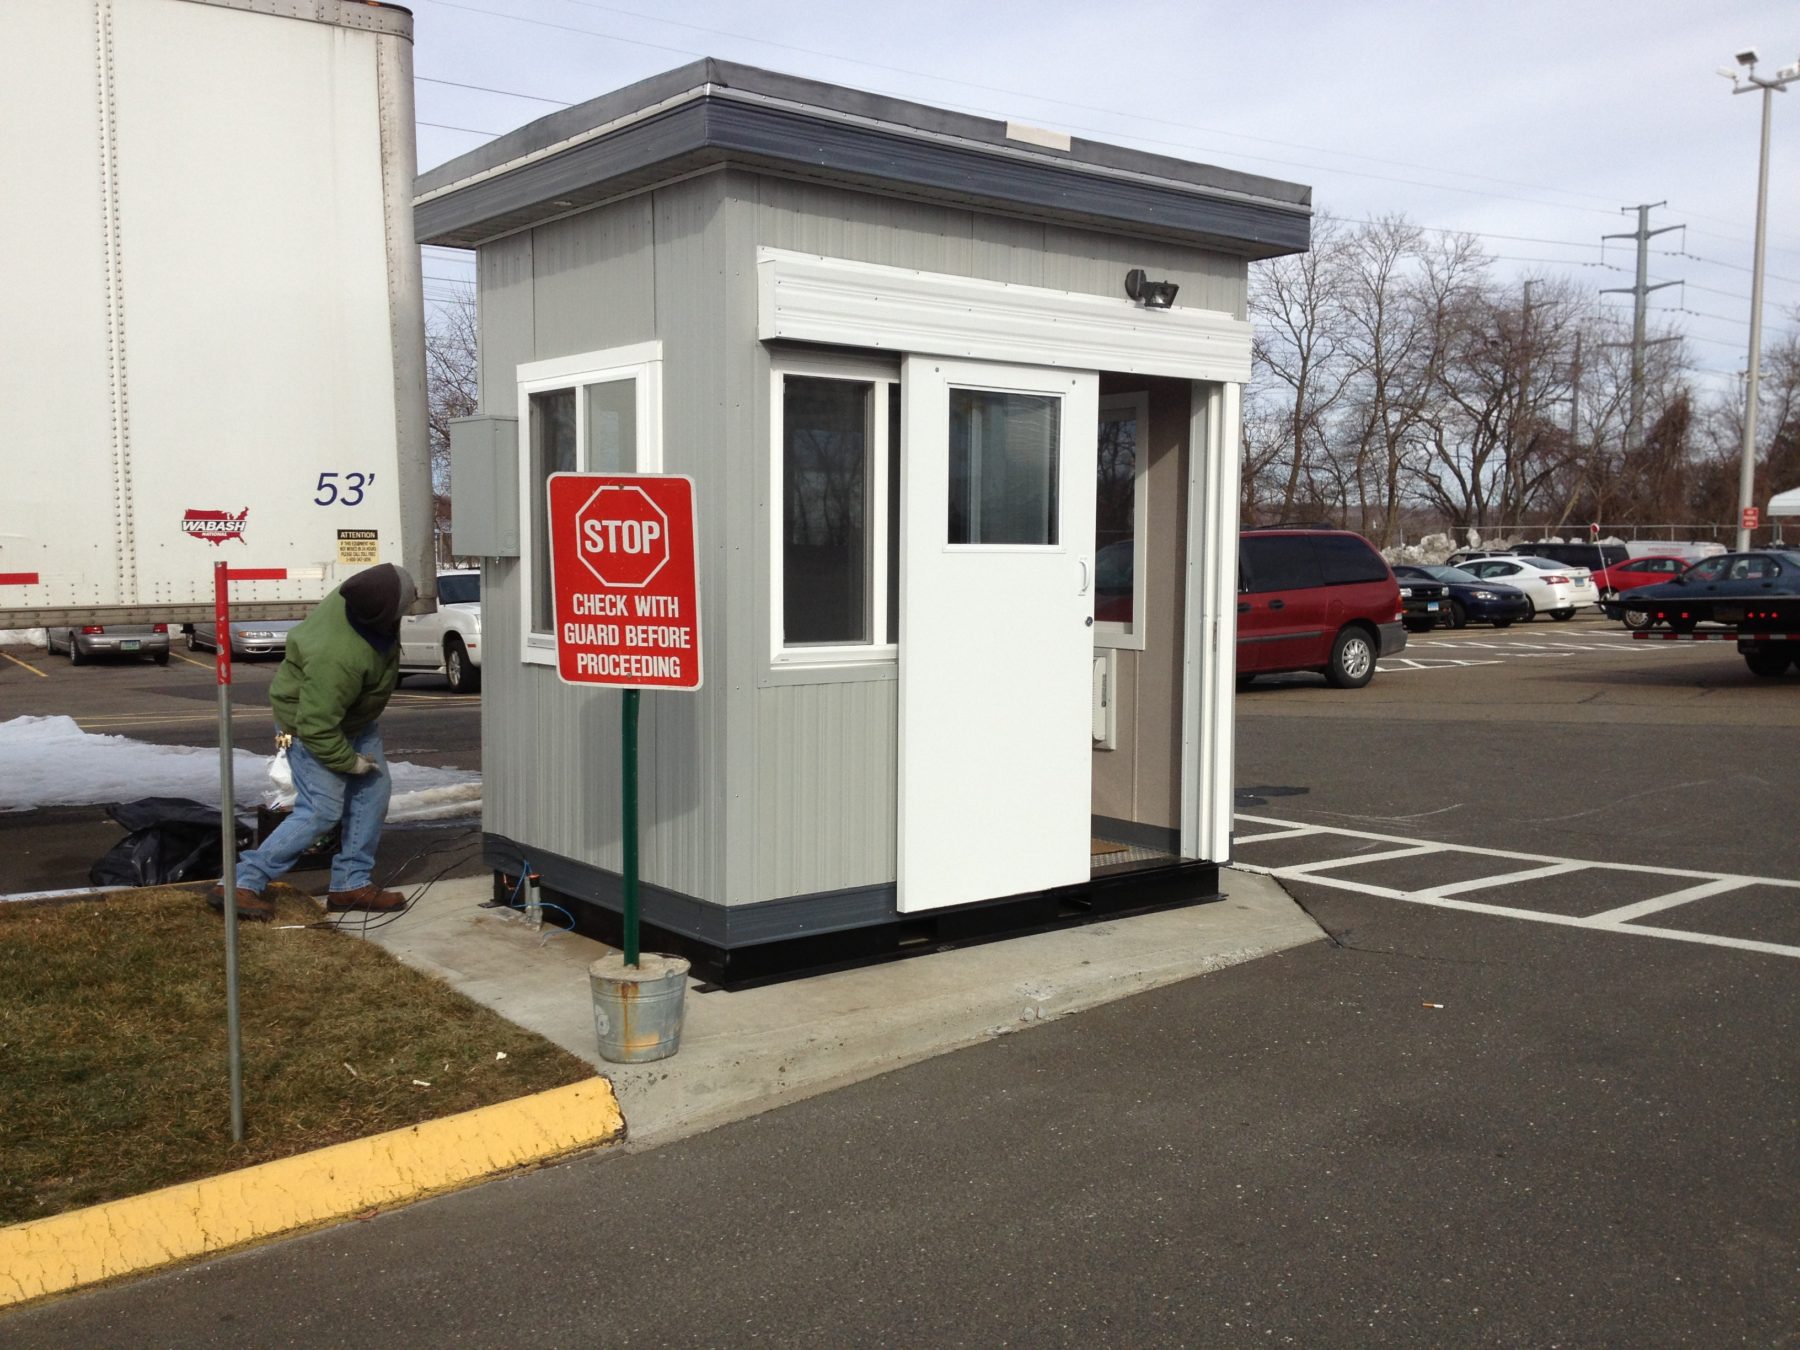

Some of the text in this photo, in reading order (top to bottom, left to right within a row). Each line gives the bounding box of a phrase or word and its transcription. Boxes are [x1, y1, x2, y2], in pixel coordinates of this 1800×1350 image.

[314, 472, 375, 506] 53'
[182, 521, 246, 531] WABASH
[584, 519, 660, 554] STOP
[573, 593, 679, 617] CHECK WITH
[564, 623, 691, 648] GUARD BEFORE
[577, 653, 681, 678] PROCEEDING
